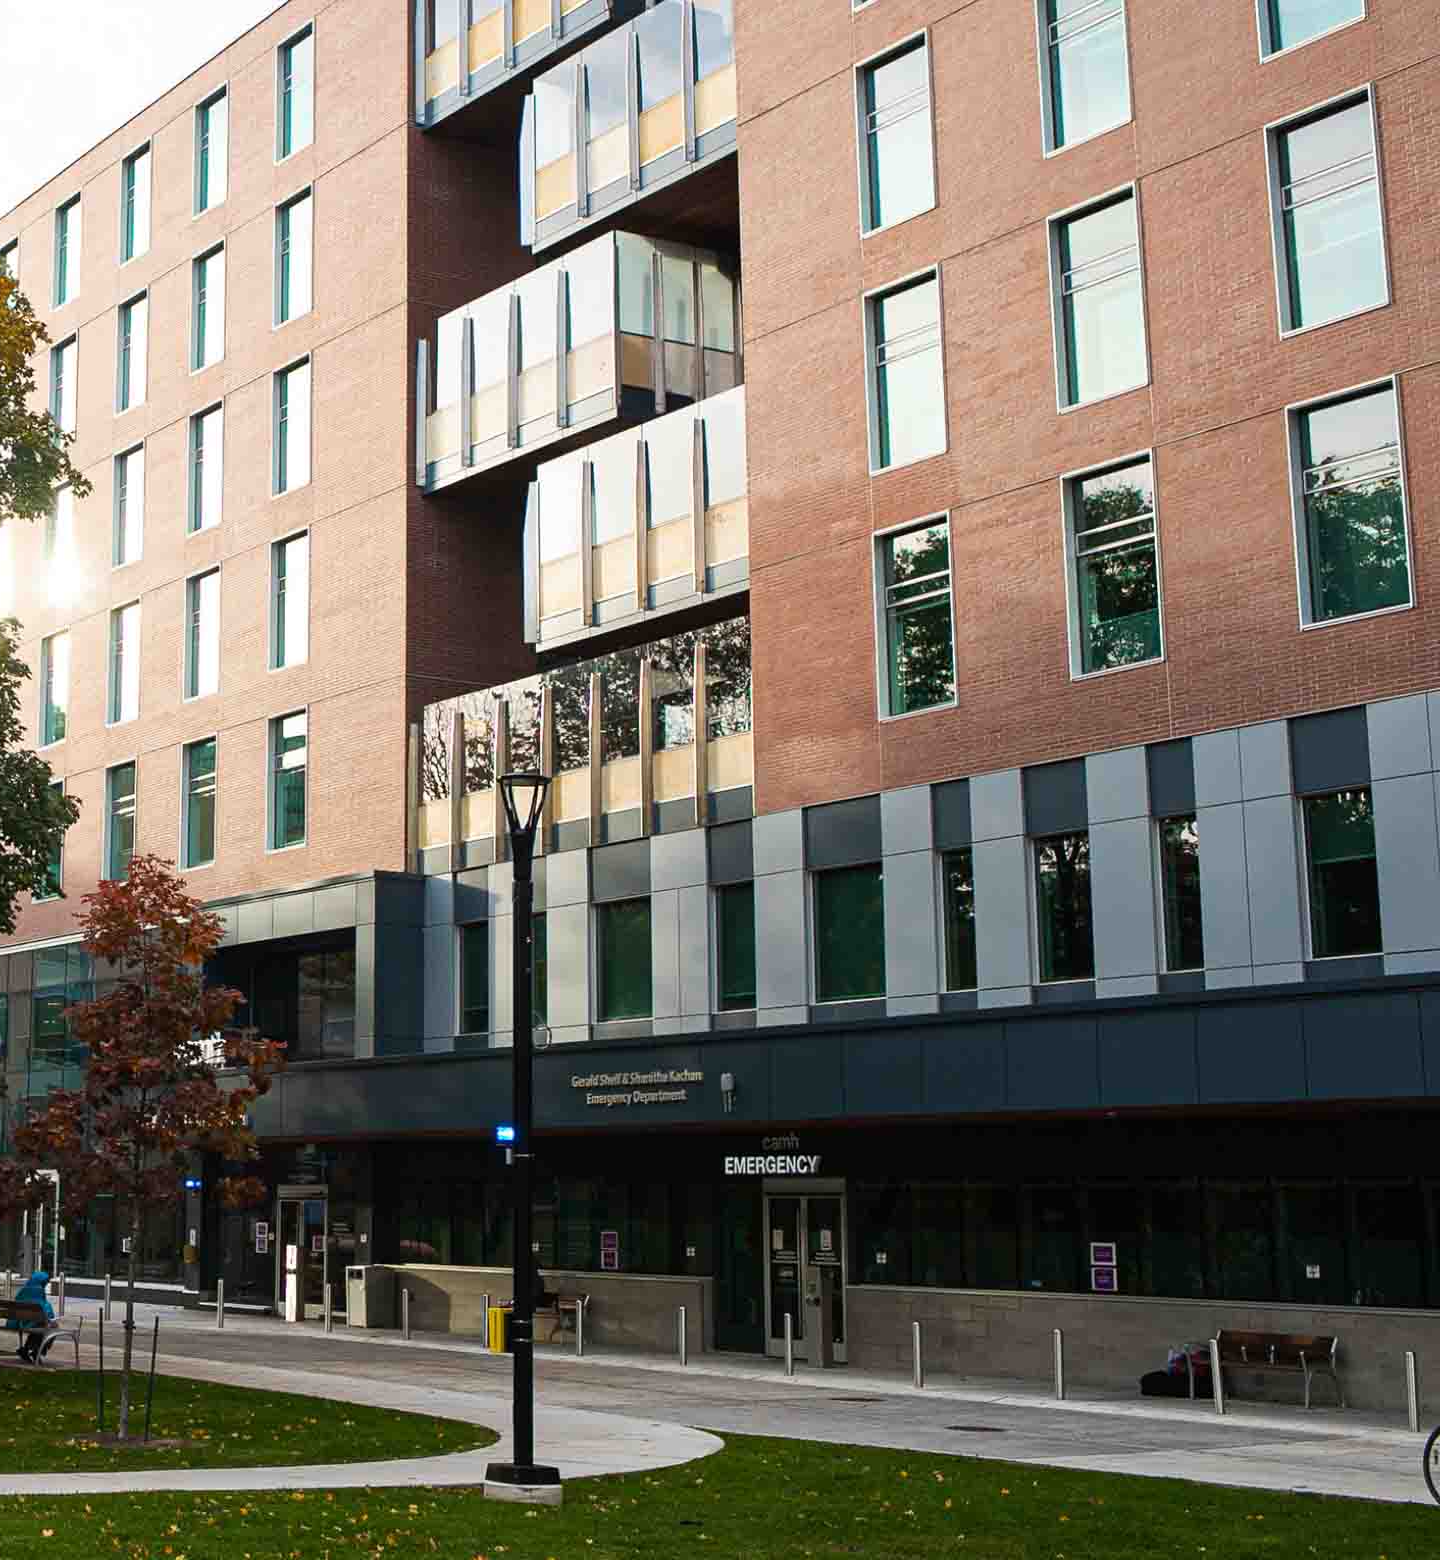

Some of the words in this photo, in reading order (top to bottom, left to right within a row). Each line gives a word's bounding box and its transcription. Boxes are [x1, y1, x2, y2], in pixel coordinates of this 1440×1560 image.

[586, 1092, 632, 1106] Emergency
[633, 1089, 688, 1104] Department
[761, 1131, 800, 1151] camh
[724, 1155, 819, 1175] EMERGENCY
